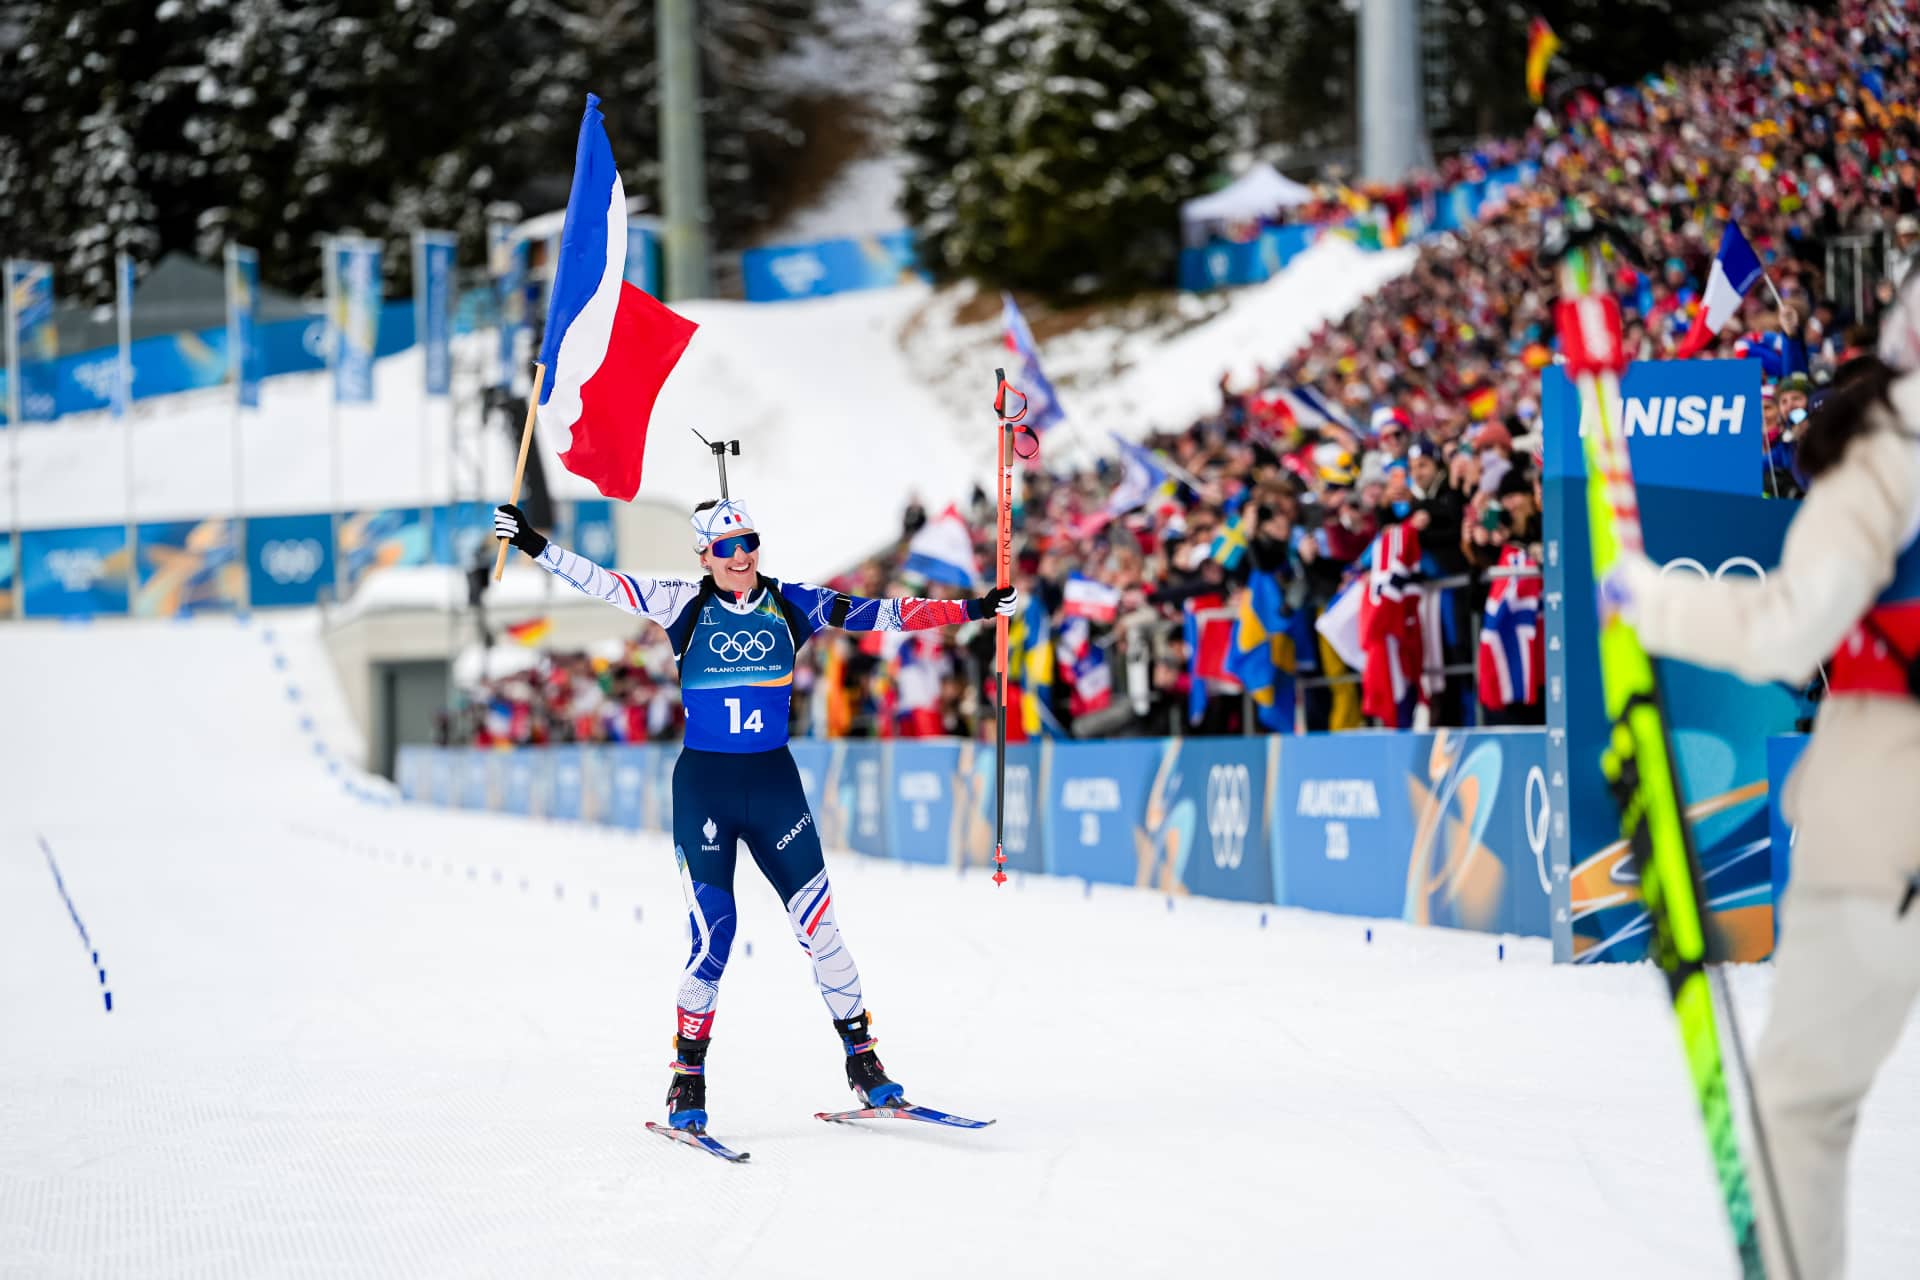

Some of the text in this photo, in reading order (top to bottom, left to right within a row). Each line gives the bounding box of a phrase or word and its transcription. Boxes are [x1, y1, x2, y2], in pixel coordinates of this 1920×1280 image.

[1578, 394, 1747, 438] NISH
[658, 580, 689, 588] CRAFT
[703, 665, 735, 673] MILANO
[735, 664, 768, 672] CORTINA
[724, 697, 764, 734] 14
[776, 816, 808, 850] CRAFT
